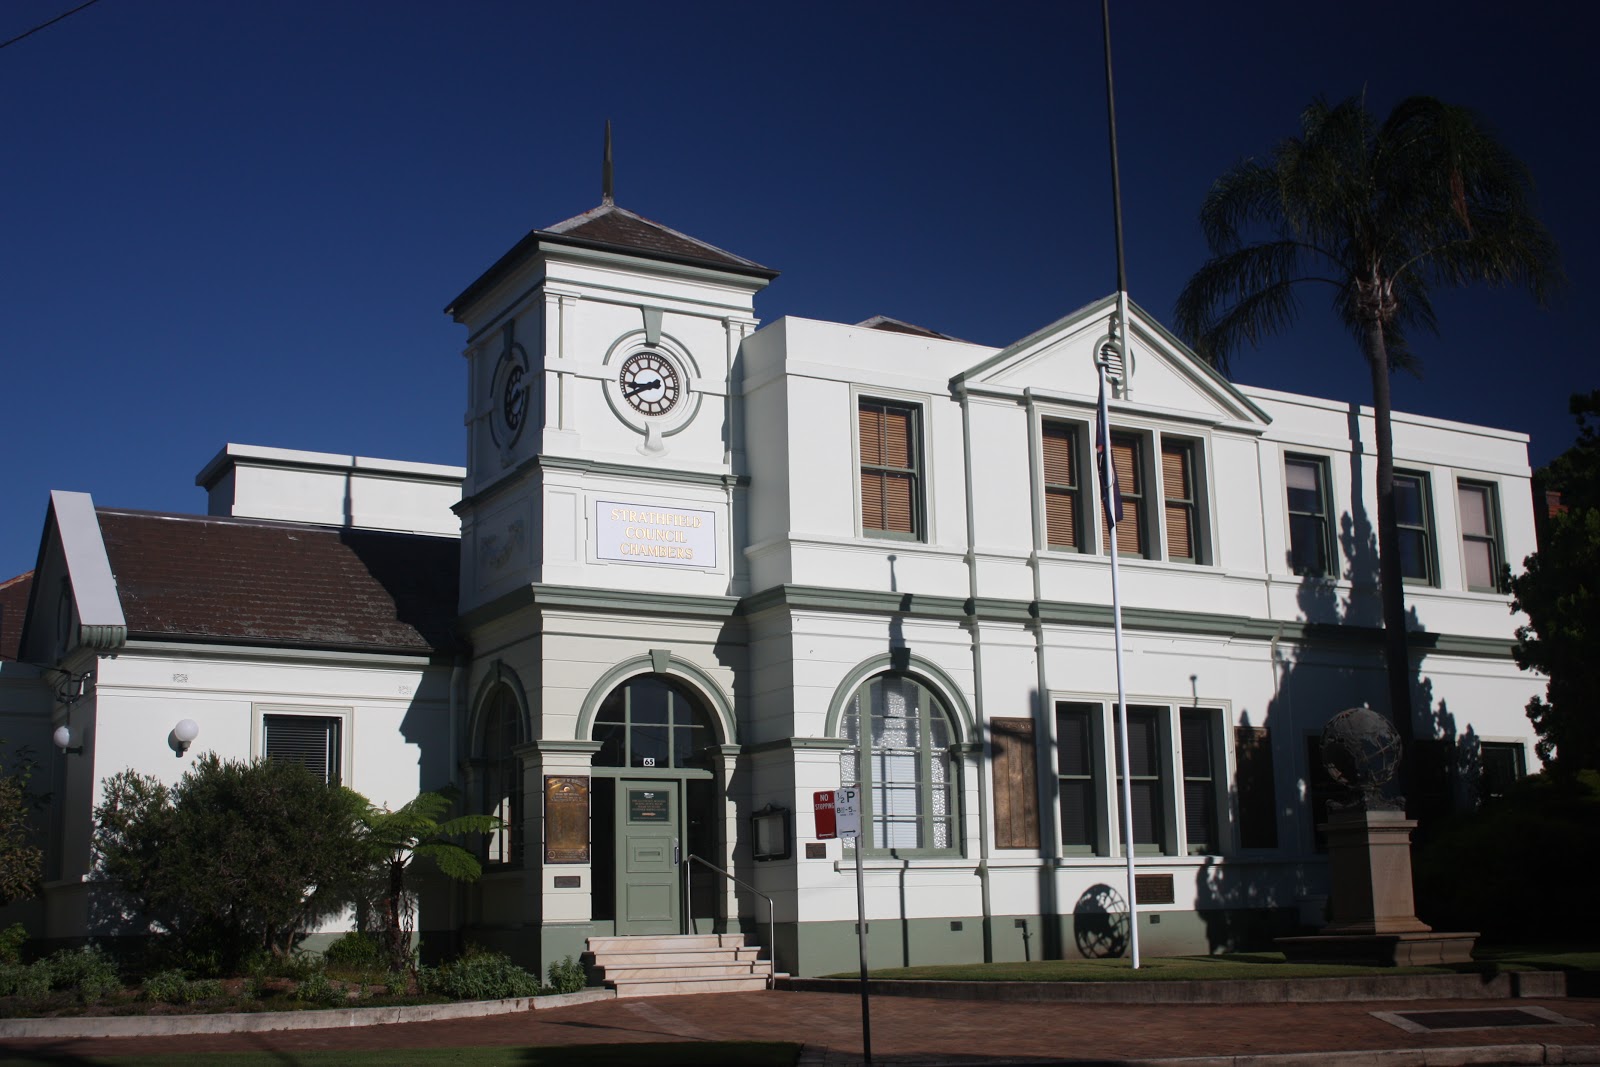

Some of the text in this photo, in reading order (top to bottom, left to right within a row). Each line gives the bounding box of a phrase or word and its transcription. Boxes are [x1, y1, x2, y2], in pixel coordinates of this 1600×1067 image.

[611, 508, 702, 528] STRATHFIELD
[625, 526, 687, 543] COUNCIL
[620, 542, 693, 560] CHAMBERS
